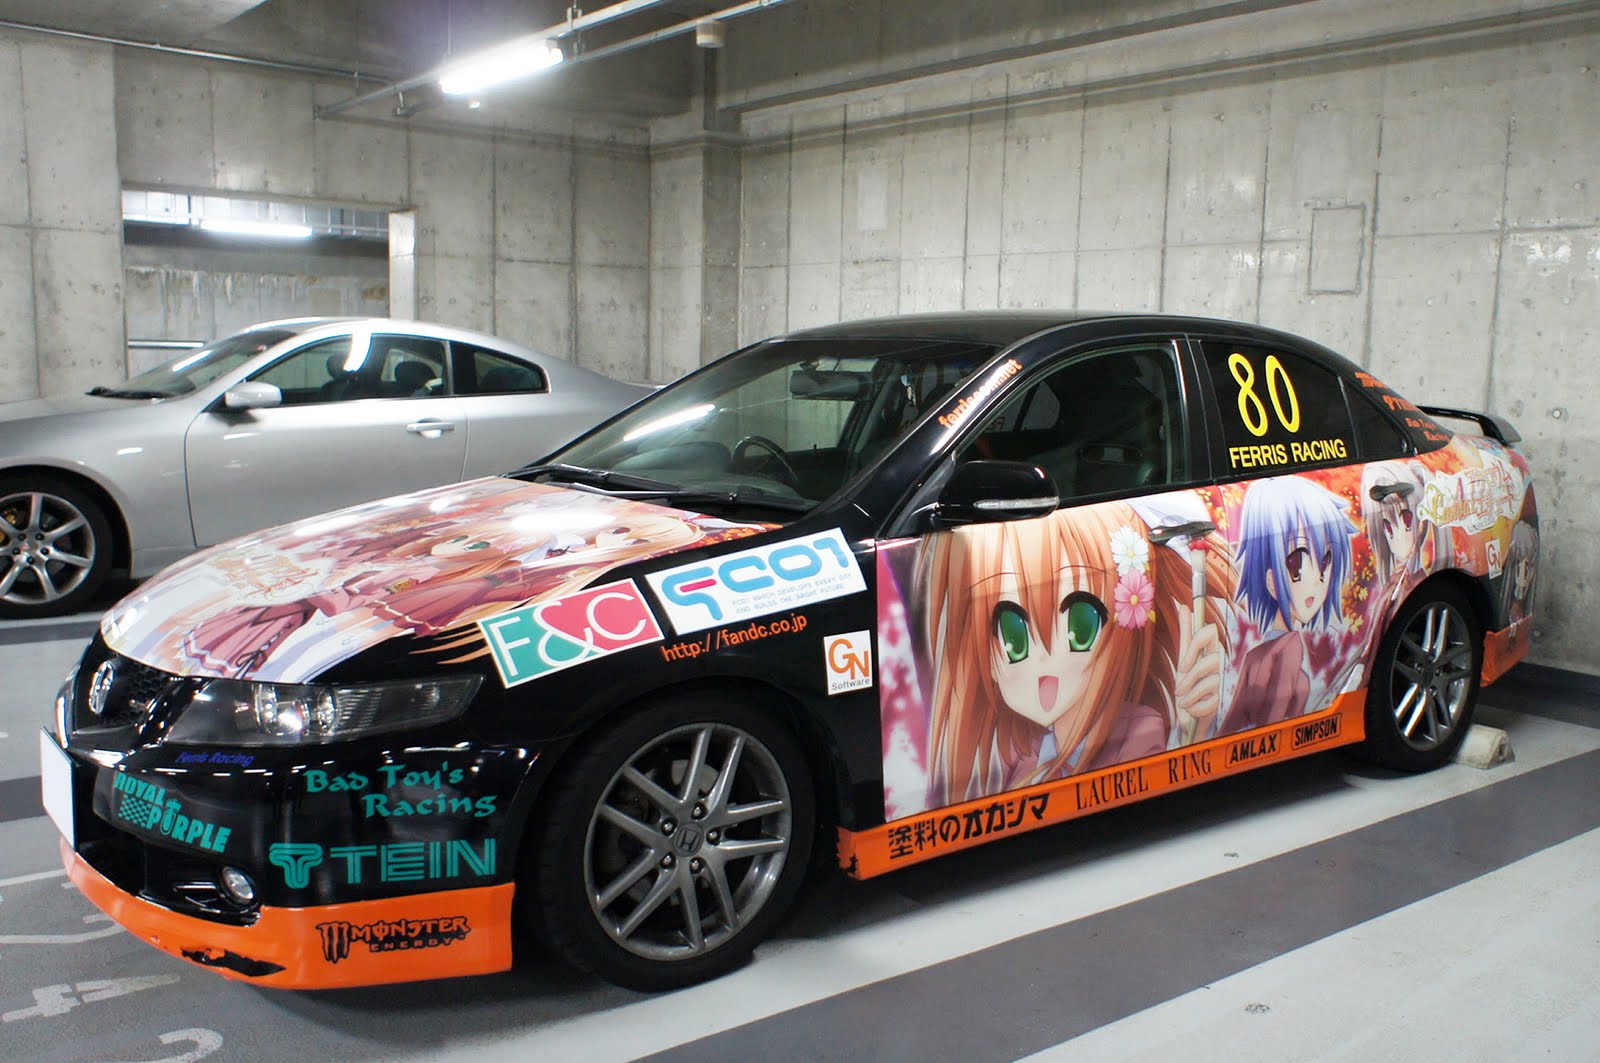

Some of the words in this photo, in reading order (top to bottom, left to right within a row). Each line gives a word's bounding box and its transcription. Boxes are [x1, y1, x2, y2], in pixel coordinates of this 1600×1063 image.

[1228, 353, 1300, 437] 80
[1228, 443, 1288, 468] FERRIS
[1290, 438, 1347, 463] RACING
[487, 591, 648, 677] F&C
[660, 613, 808, 662] http://fandc.co.jp
[832, 677, 871, 691] Software
[1294, 717, 1339, 747] SIMPSON
[209, 751, 256, 768] Racing
[1229, 733, 1278, 765] AMLAX
[113, 772, 167, 806] ROYAL
[302, 769, 369, 793] Bad
[377, 761, 464, 790] Toy's
[1075, 766, 1149, 810] LAUREL
[1168, 748, 1212, 784] RING
[360, 793, 498, 819] Racing
[147, 798, 233, 854] PURPLE
[330, 838, 496, 885] TEIN
[351, 915, 472, 943] MONSTER
[369, 938, 453, 952] ENERGY
